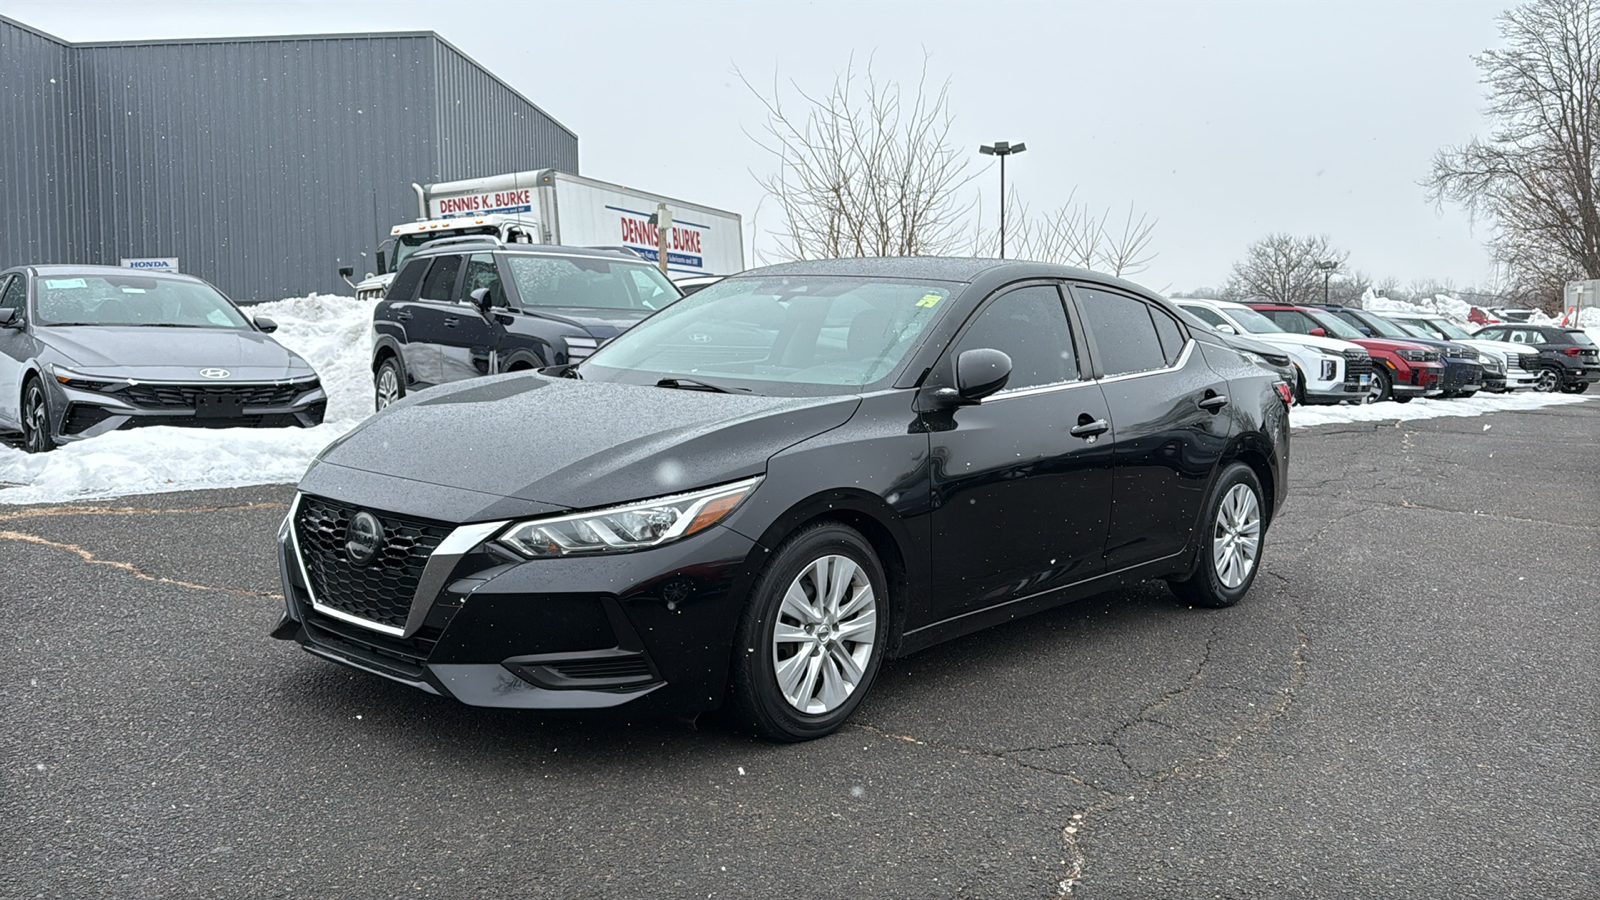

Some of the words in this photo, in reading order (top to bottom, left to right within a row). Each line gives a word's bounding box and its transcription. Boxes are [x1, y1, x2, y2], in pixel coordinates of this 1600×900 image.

[440, 196, 480, 213] DENNIS
[482, 195, 493, 209] K.
[495, 190, 530, 207] BURKE
[621, 217, 659, 247] DENNIS
[672, 227, 701, 253] BURKE
